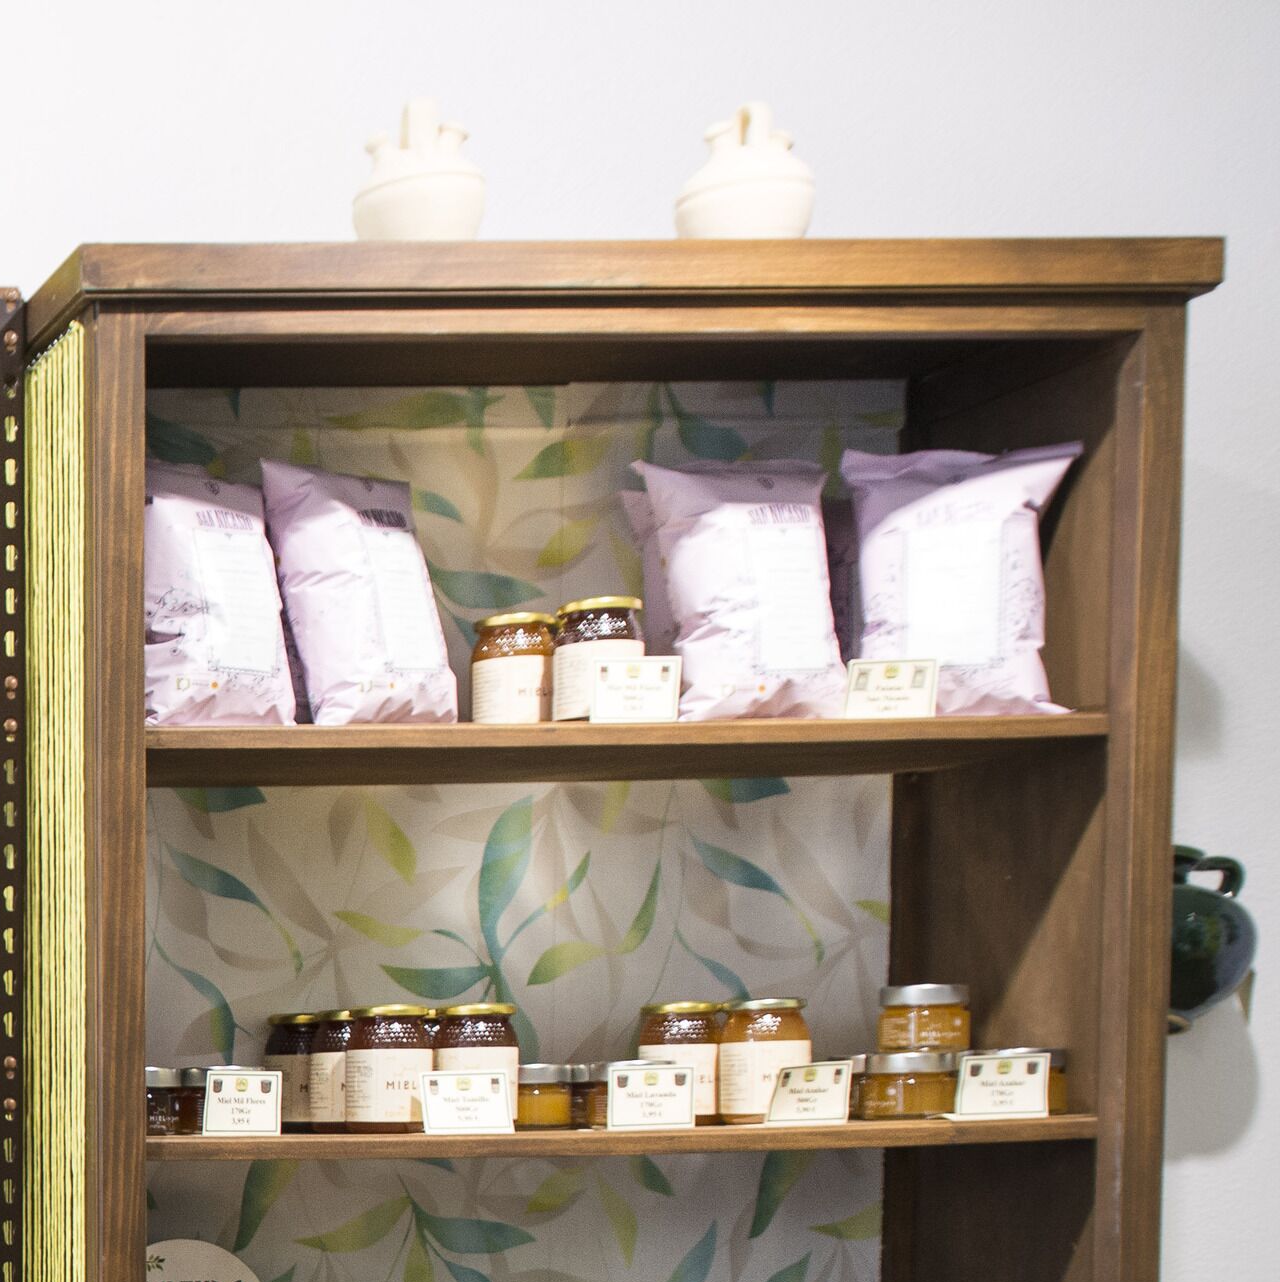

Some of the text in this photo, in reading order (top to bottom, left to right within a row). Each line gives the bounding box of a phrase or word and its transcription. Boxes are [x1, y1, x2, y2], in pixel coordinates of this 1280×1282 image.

[385, 1080, 416, 1091] MIEL
[217, 1097, 266, 1105] Miel Flores
